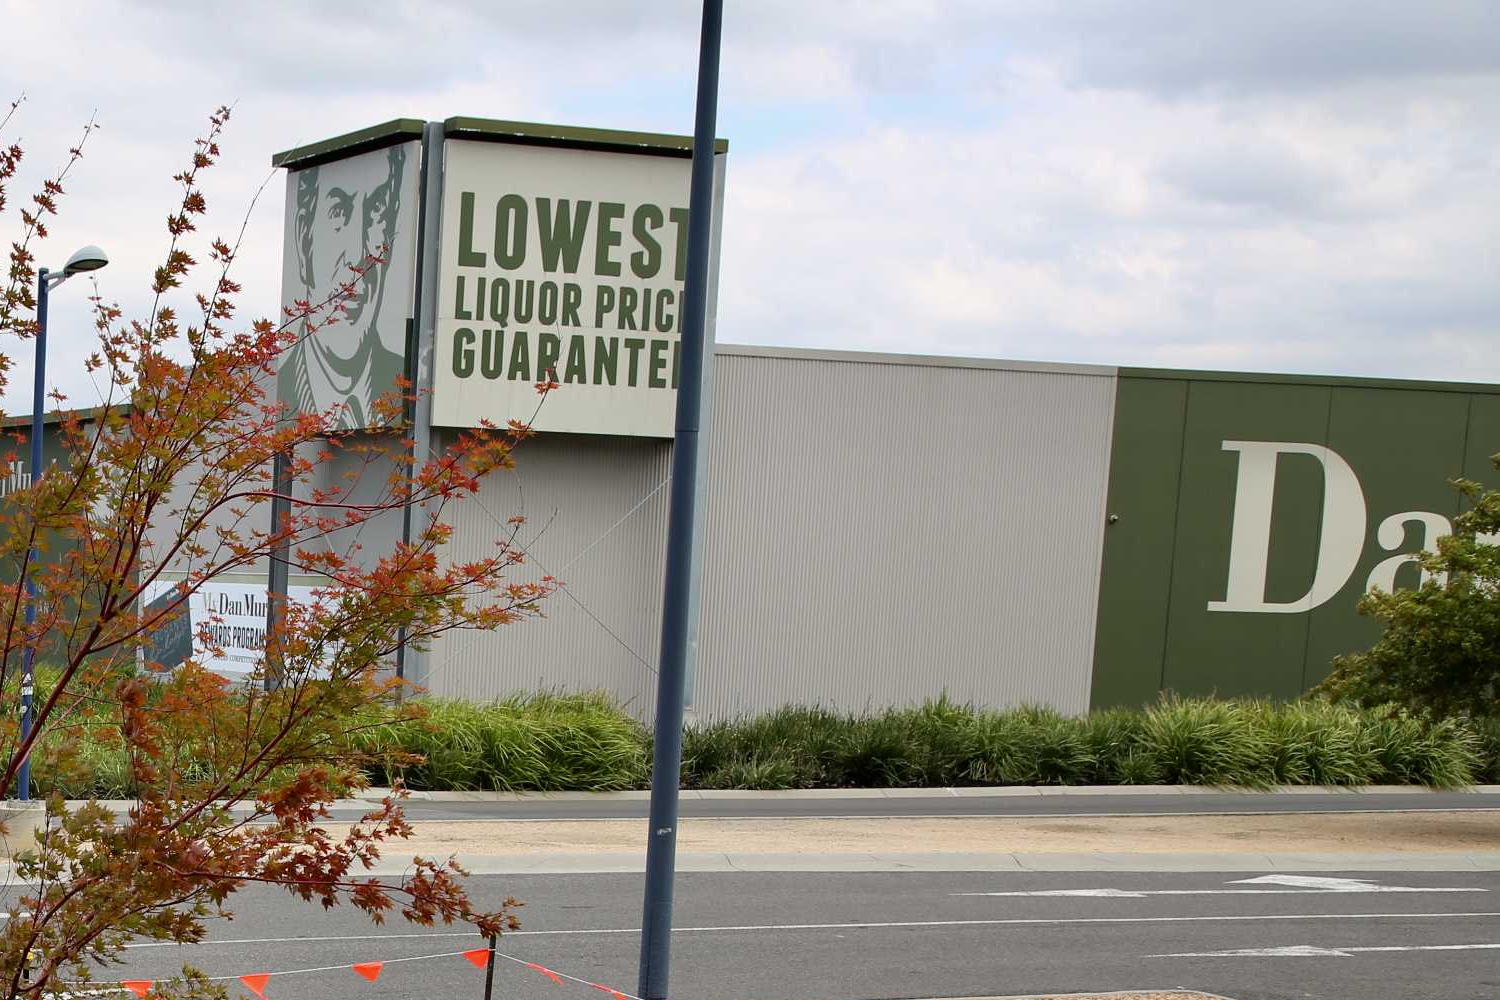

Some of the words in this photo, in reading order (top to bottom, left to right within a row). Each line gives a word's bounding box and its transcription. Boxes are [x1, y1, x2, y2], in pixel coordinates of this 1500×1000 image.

[457, 192, 690, 281] LOWEST
[454, 275, 583, 328] LIQUOR
[595, 285, 684, 334] PRIC
[1207, 440, 1500, 613] Da
[219, 593, 243, 616] Dan
